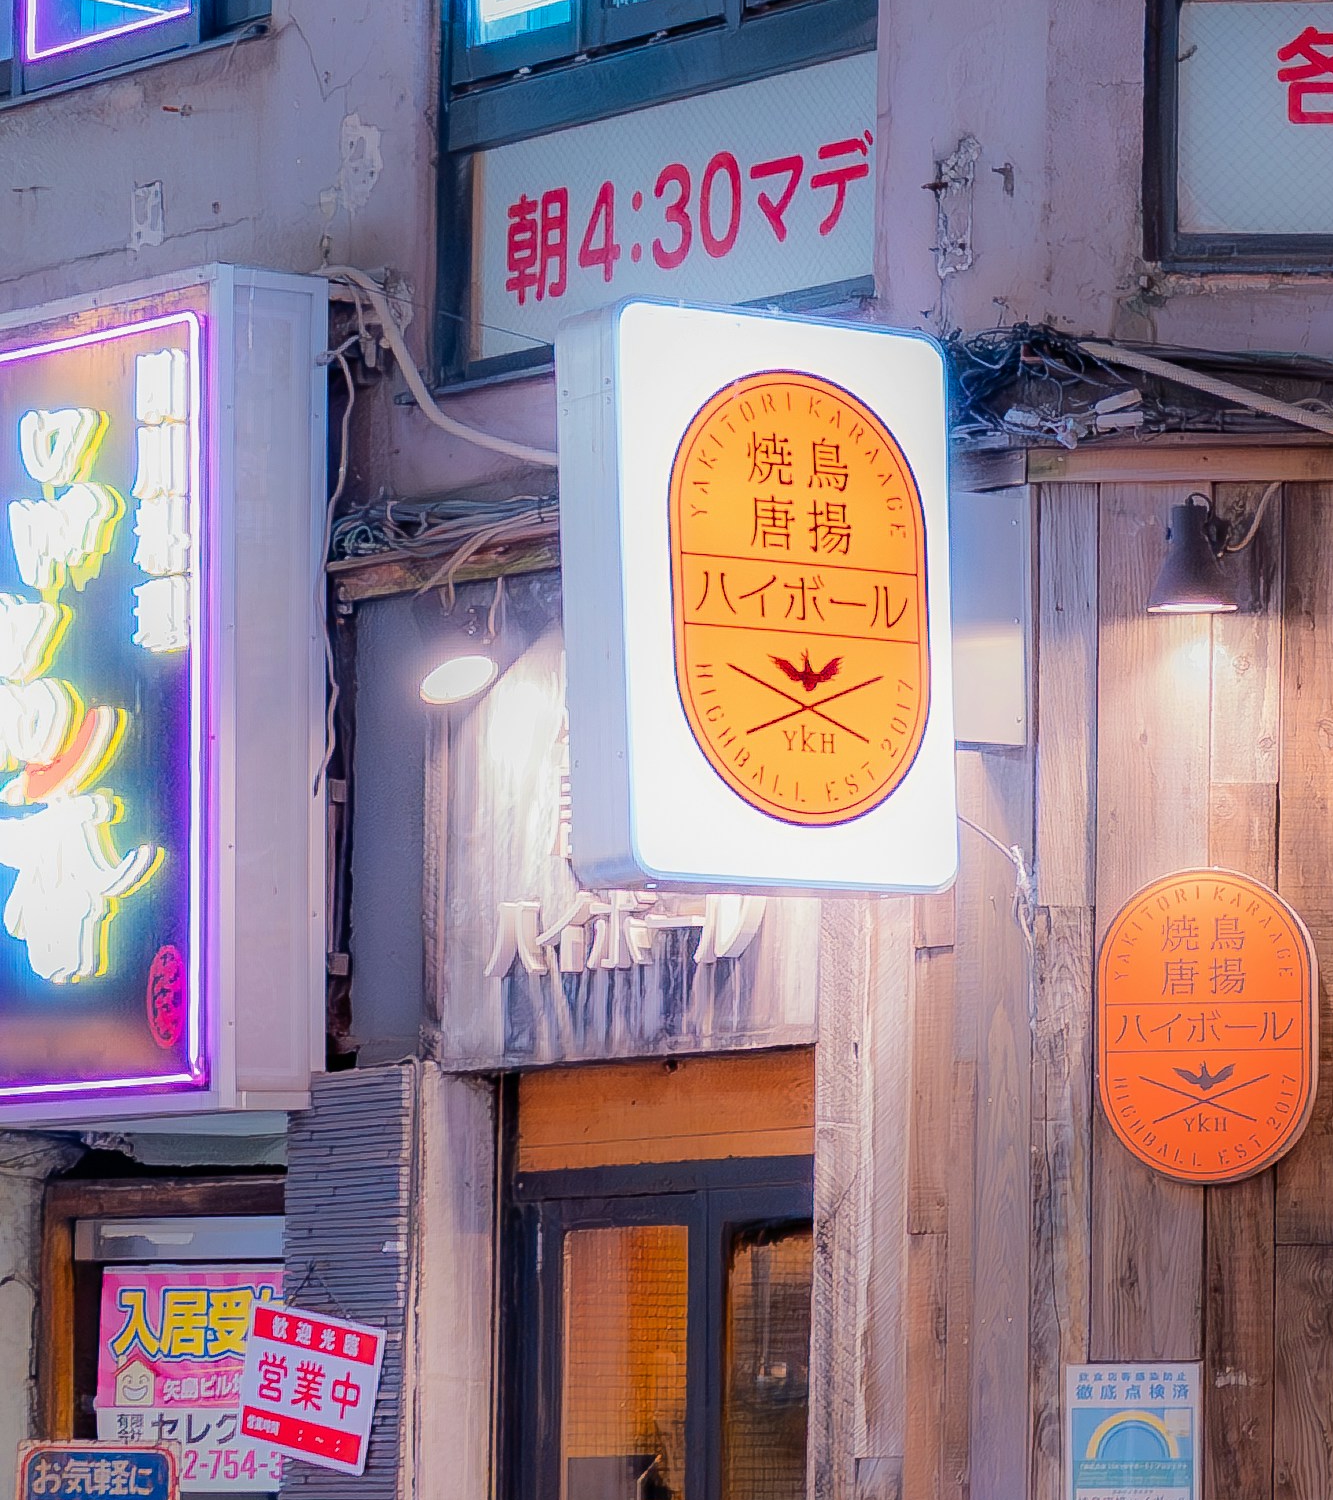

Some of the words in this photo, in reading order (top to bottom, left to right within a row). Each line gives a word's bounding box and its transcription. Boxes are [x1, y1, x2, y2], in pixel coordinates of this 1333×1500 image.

[505, 127, 876, 309] 朝4:30マデ
[691, 392, 795, 519] YAKITORI
[807, 397, 908, 540] KARAAGE
[746, 431, 851, 494] 焼鳥
[749, 494, 853, 556] 唐揚
[695, 570, 909, 630] ハイボール
[825, 760, 879, 803] EST
[881, 676, 915, 759] 2017
[1160, 914, 1246, 953] 焼鳥
[1160, 956, 1248, 996] 唐揚
[1114, 1008, 1295, 1044] ハイボール
[111, 1287, 284, 1362] 入居受
[258, 1350, 362, 1422] 営業中
[30, 1458, 154, 1498] お気軽に
